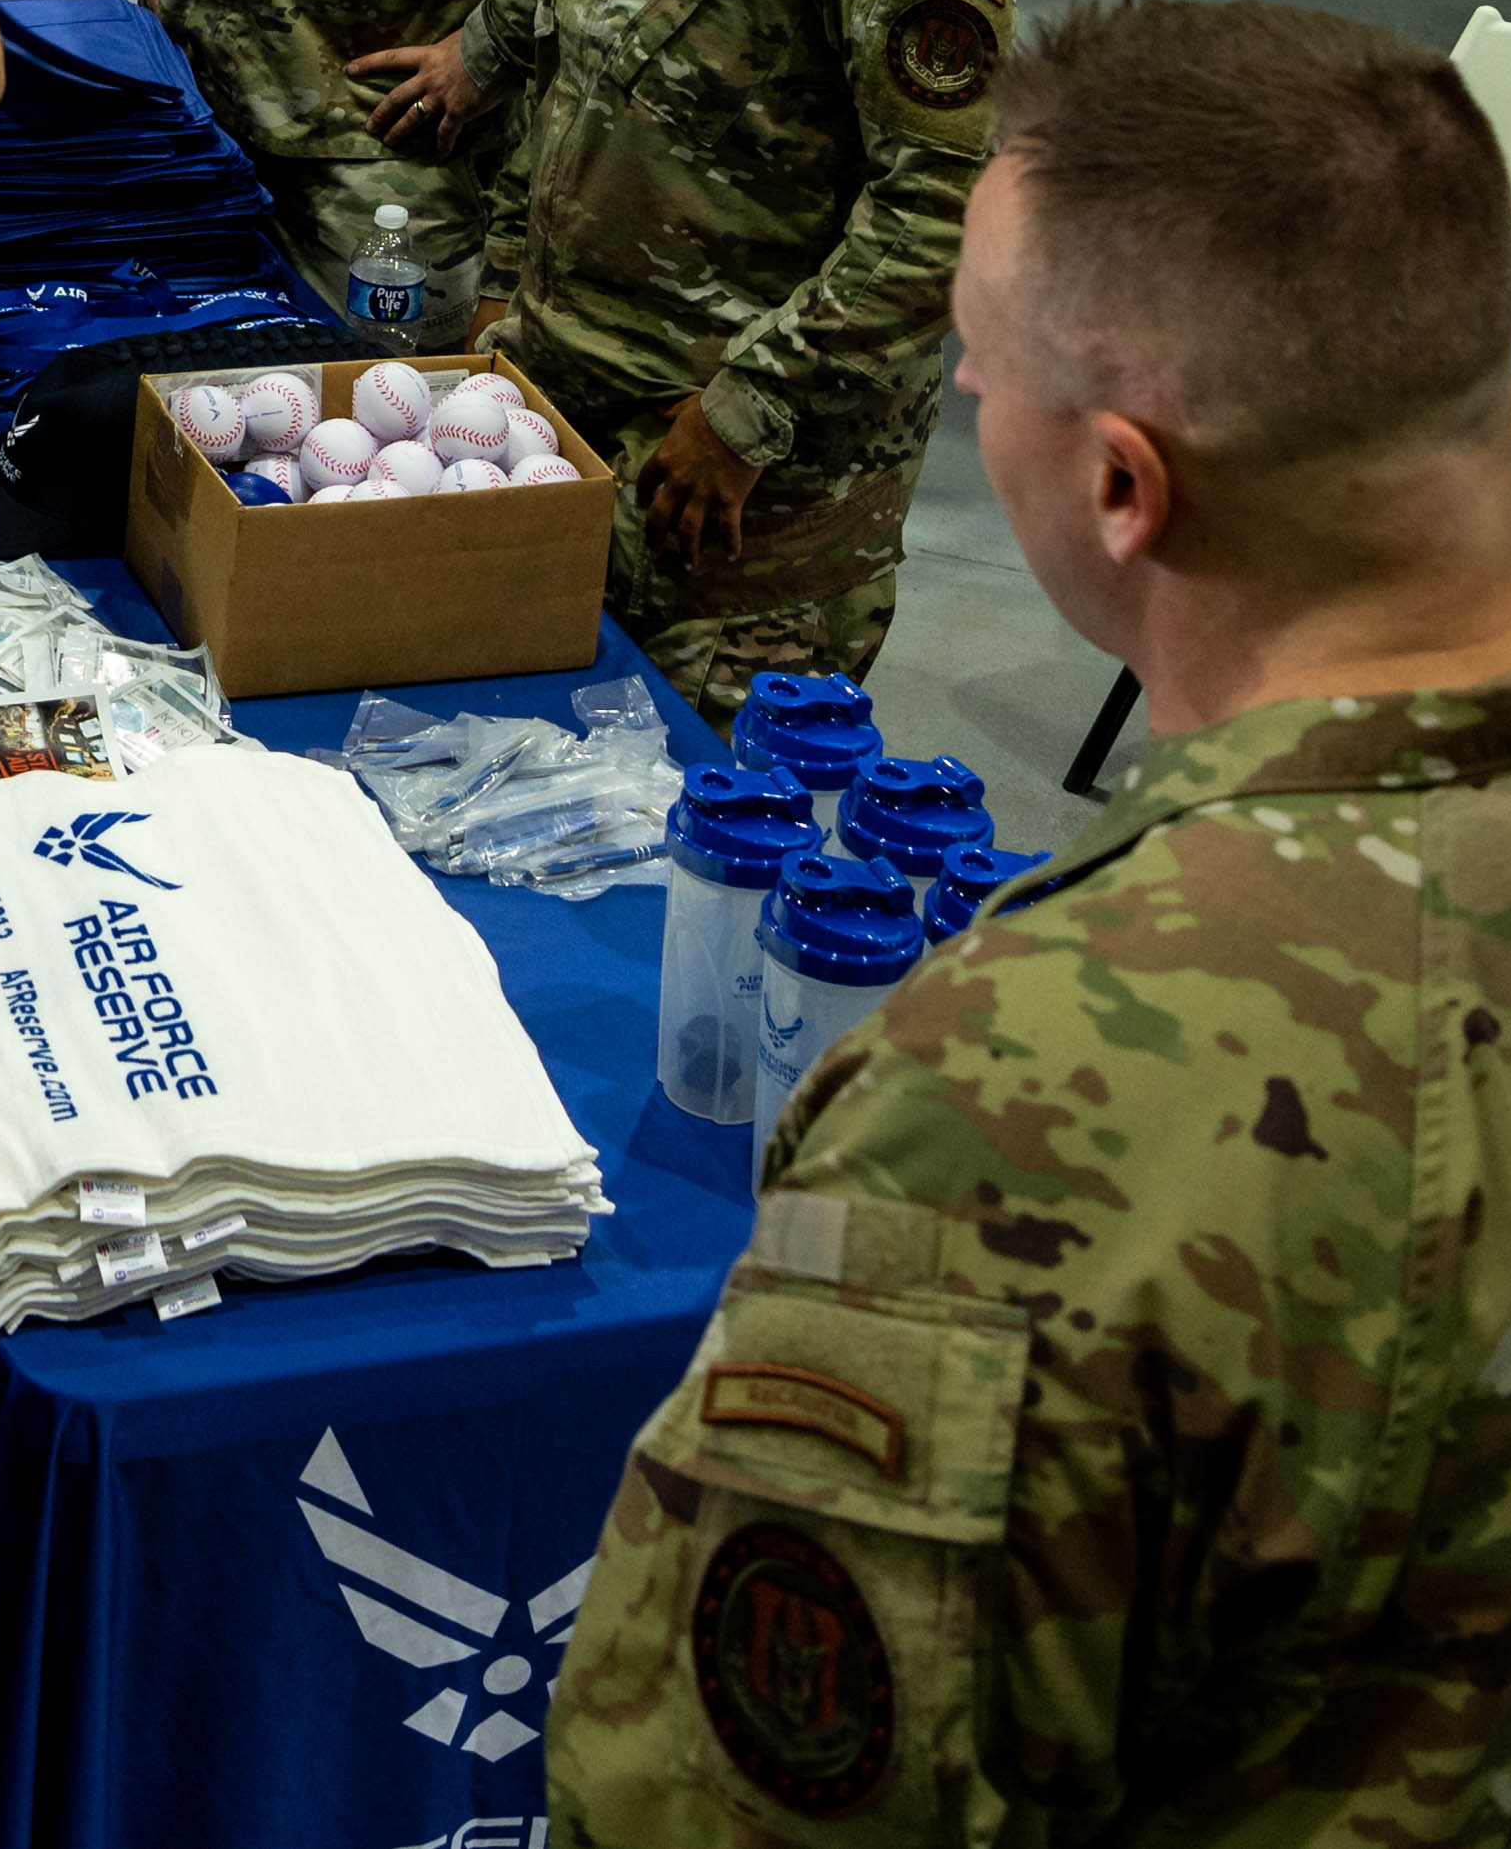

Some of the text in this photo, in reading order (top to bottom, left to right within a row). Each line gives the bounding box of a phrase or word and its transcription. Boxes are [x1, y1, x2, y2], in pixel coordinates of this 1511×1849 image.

[54, 286, 88, 302] AIR
[376, 287, 406, 300] Pure
[379, 298, 401, 312] Life
[63, 914, 168, 1100] RESERVE
[99, 899, 218, 1100] AIR FORCE
